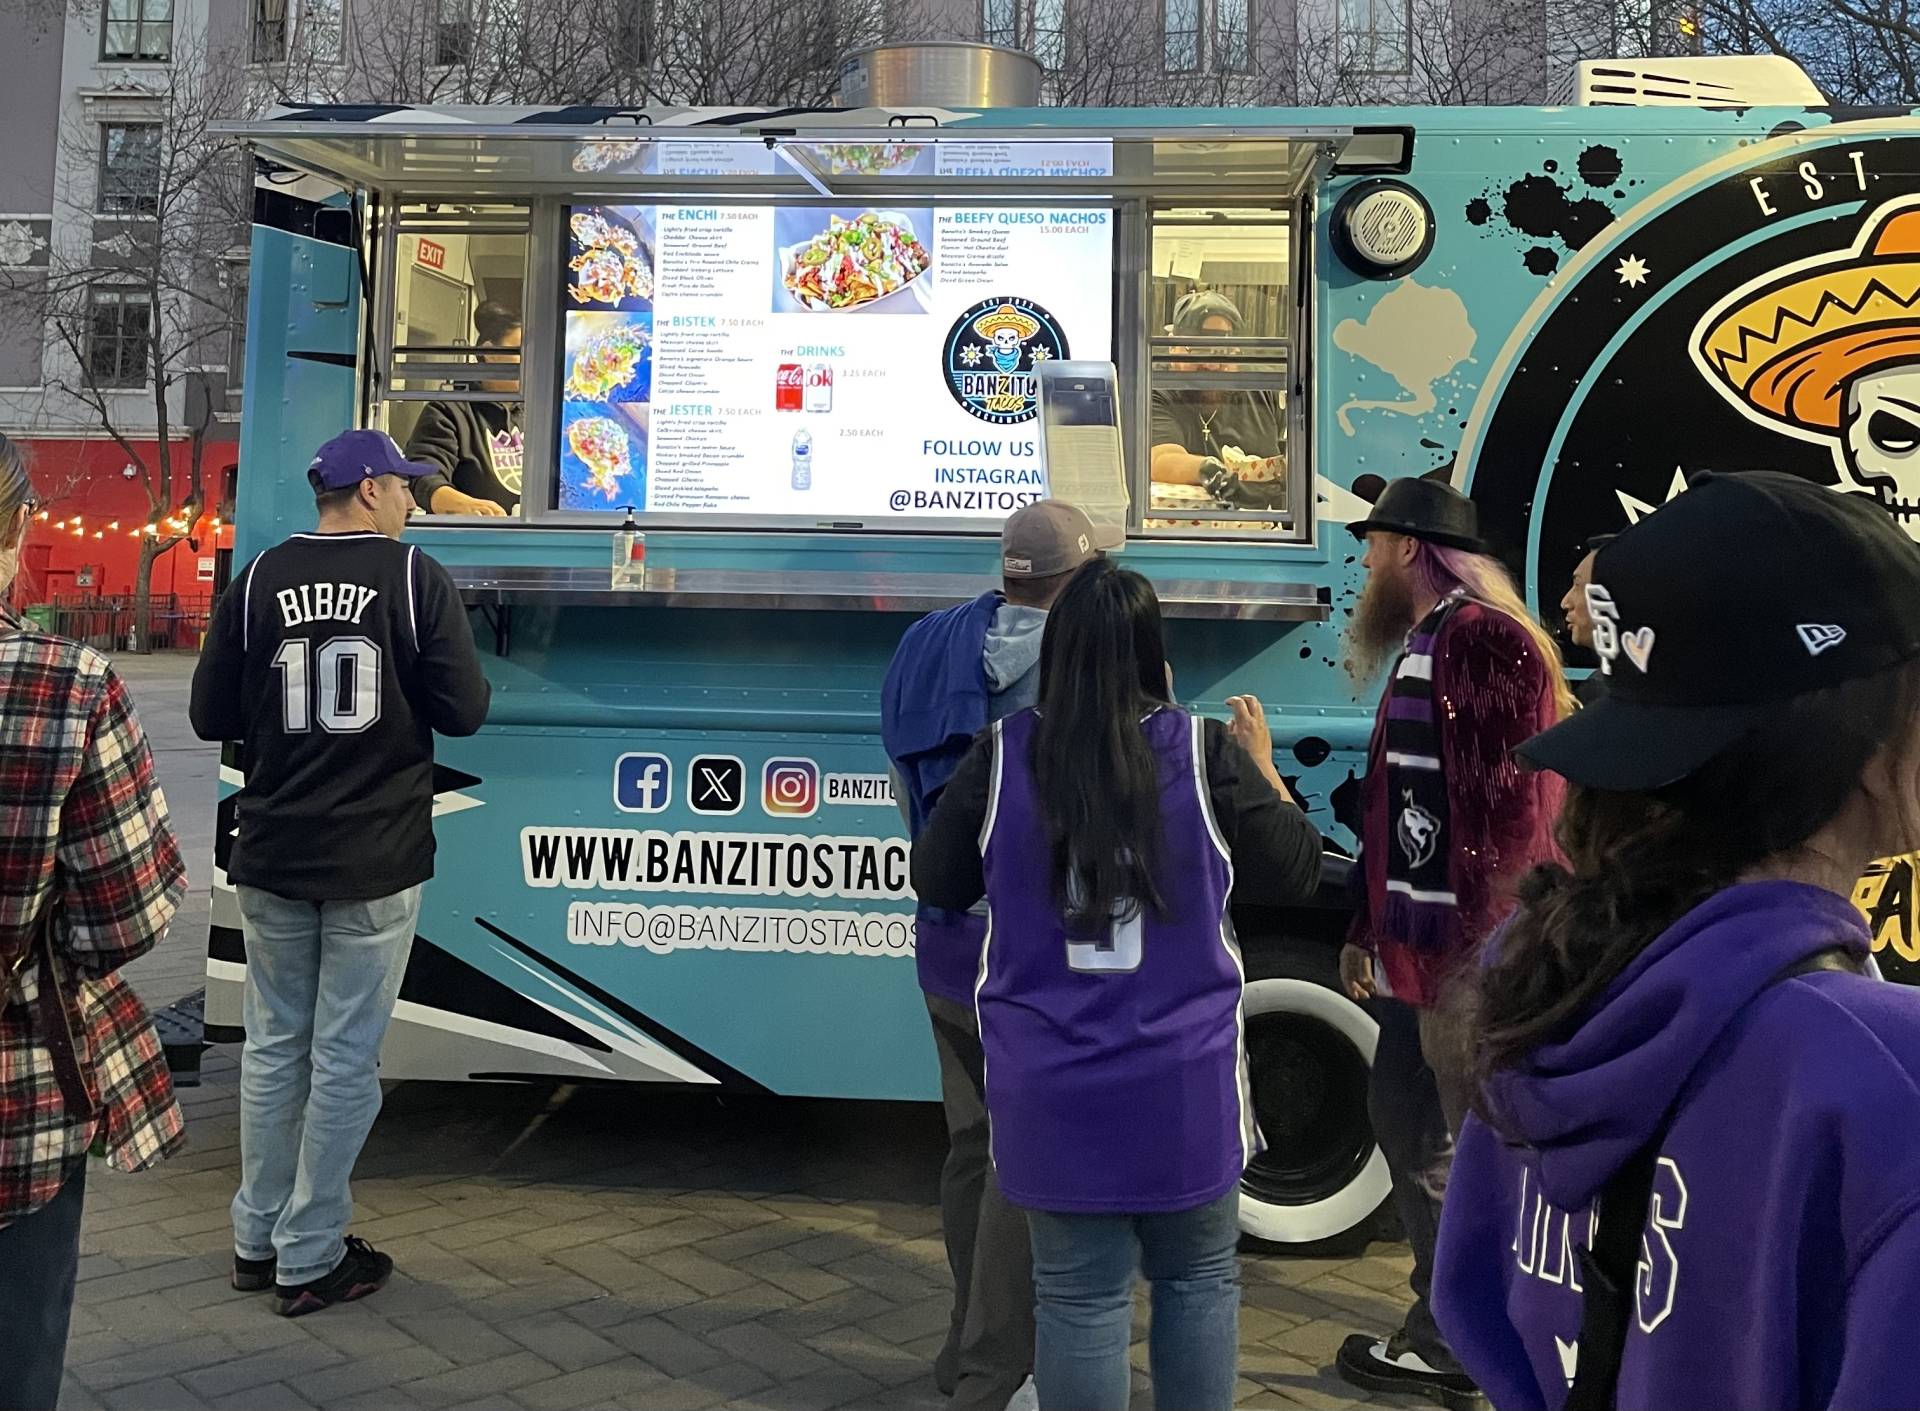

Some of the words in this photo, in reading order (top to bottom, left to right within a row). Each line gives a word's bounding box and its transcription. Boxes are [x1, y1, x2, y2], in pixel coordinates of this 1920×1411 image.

[678, 210, 717, 220] ENCHI
[955, 213, 994, 224] BEEFY
[998, 213, 1044, 225] QUESO
[1050, 213, 1106, 224] NACHOS
[1040, 226, 1063, 234] 15.00
[1065, 226, 1089, 234] EACH
[420, 243, 444, 266] EXIT
[672, 316, 715, 327] BISTEK
[721, 319, 738, 327] 7.50
[741, 319, 764, 327] EACH
[796, 345, 846, 357] DRINKS
[669, 404, 712, 416] JESTER
[718, 408, 736, 416] 7.50
[738, 408, 761, 416] EACH
[987, 397, 1024, 412] TACOS
[839, 429, 857, 437] 2.50
[860, 429, 884, 437] EACH
[923, 440, 1002, 456] FOLLOW
[1009, 441, 1034, 457] US
[276, 583, 378, 627] BIBBY
[270, 635, 382, 733] 10
